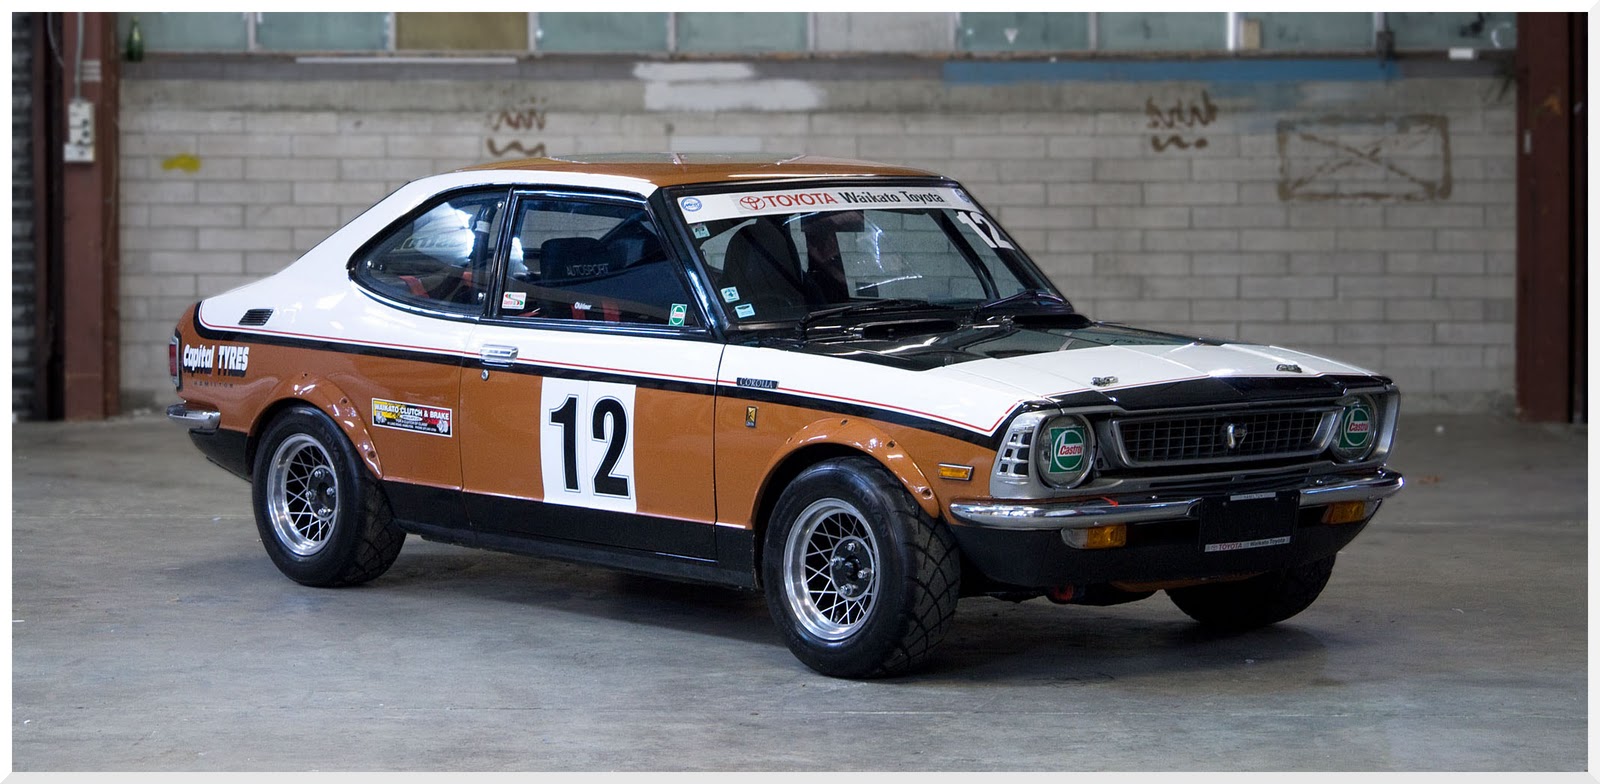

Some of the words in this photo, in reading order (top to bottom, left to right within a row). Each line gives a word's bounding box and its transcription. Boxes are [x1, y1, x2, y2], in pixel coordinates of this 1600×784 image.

[763, 192, 838, 208] TOYOTA
[839, 191, 901, 204] Waikato
[899, 190, 945, 205] Toyota
[956, 211, 1016, 251] 12
[183, 344, 215, 371] Capital
[218, 345, 250, 373] TYRES
[739, 378, 773, 389] COROLLA
[375, 404, 399, 413] WAIKATO
[400, 407, 423, 417] CLUTCH
[430, 411, 450, 420] BRAKE
[549, 393, 631, 499] 12
[1219, 542, 1243, 550] TOYOTA
